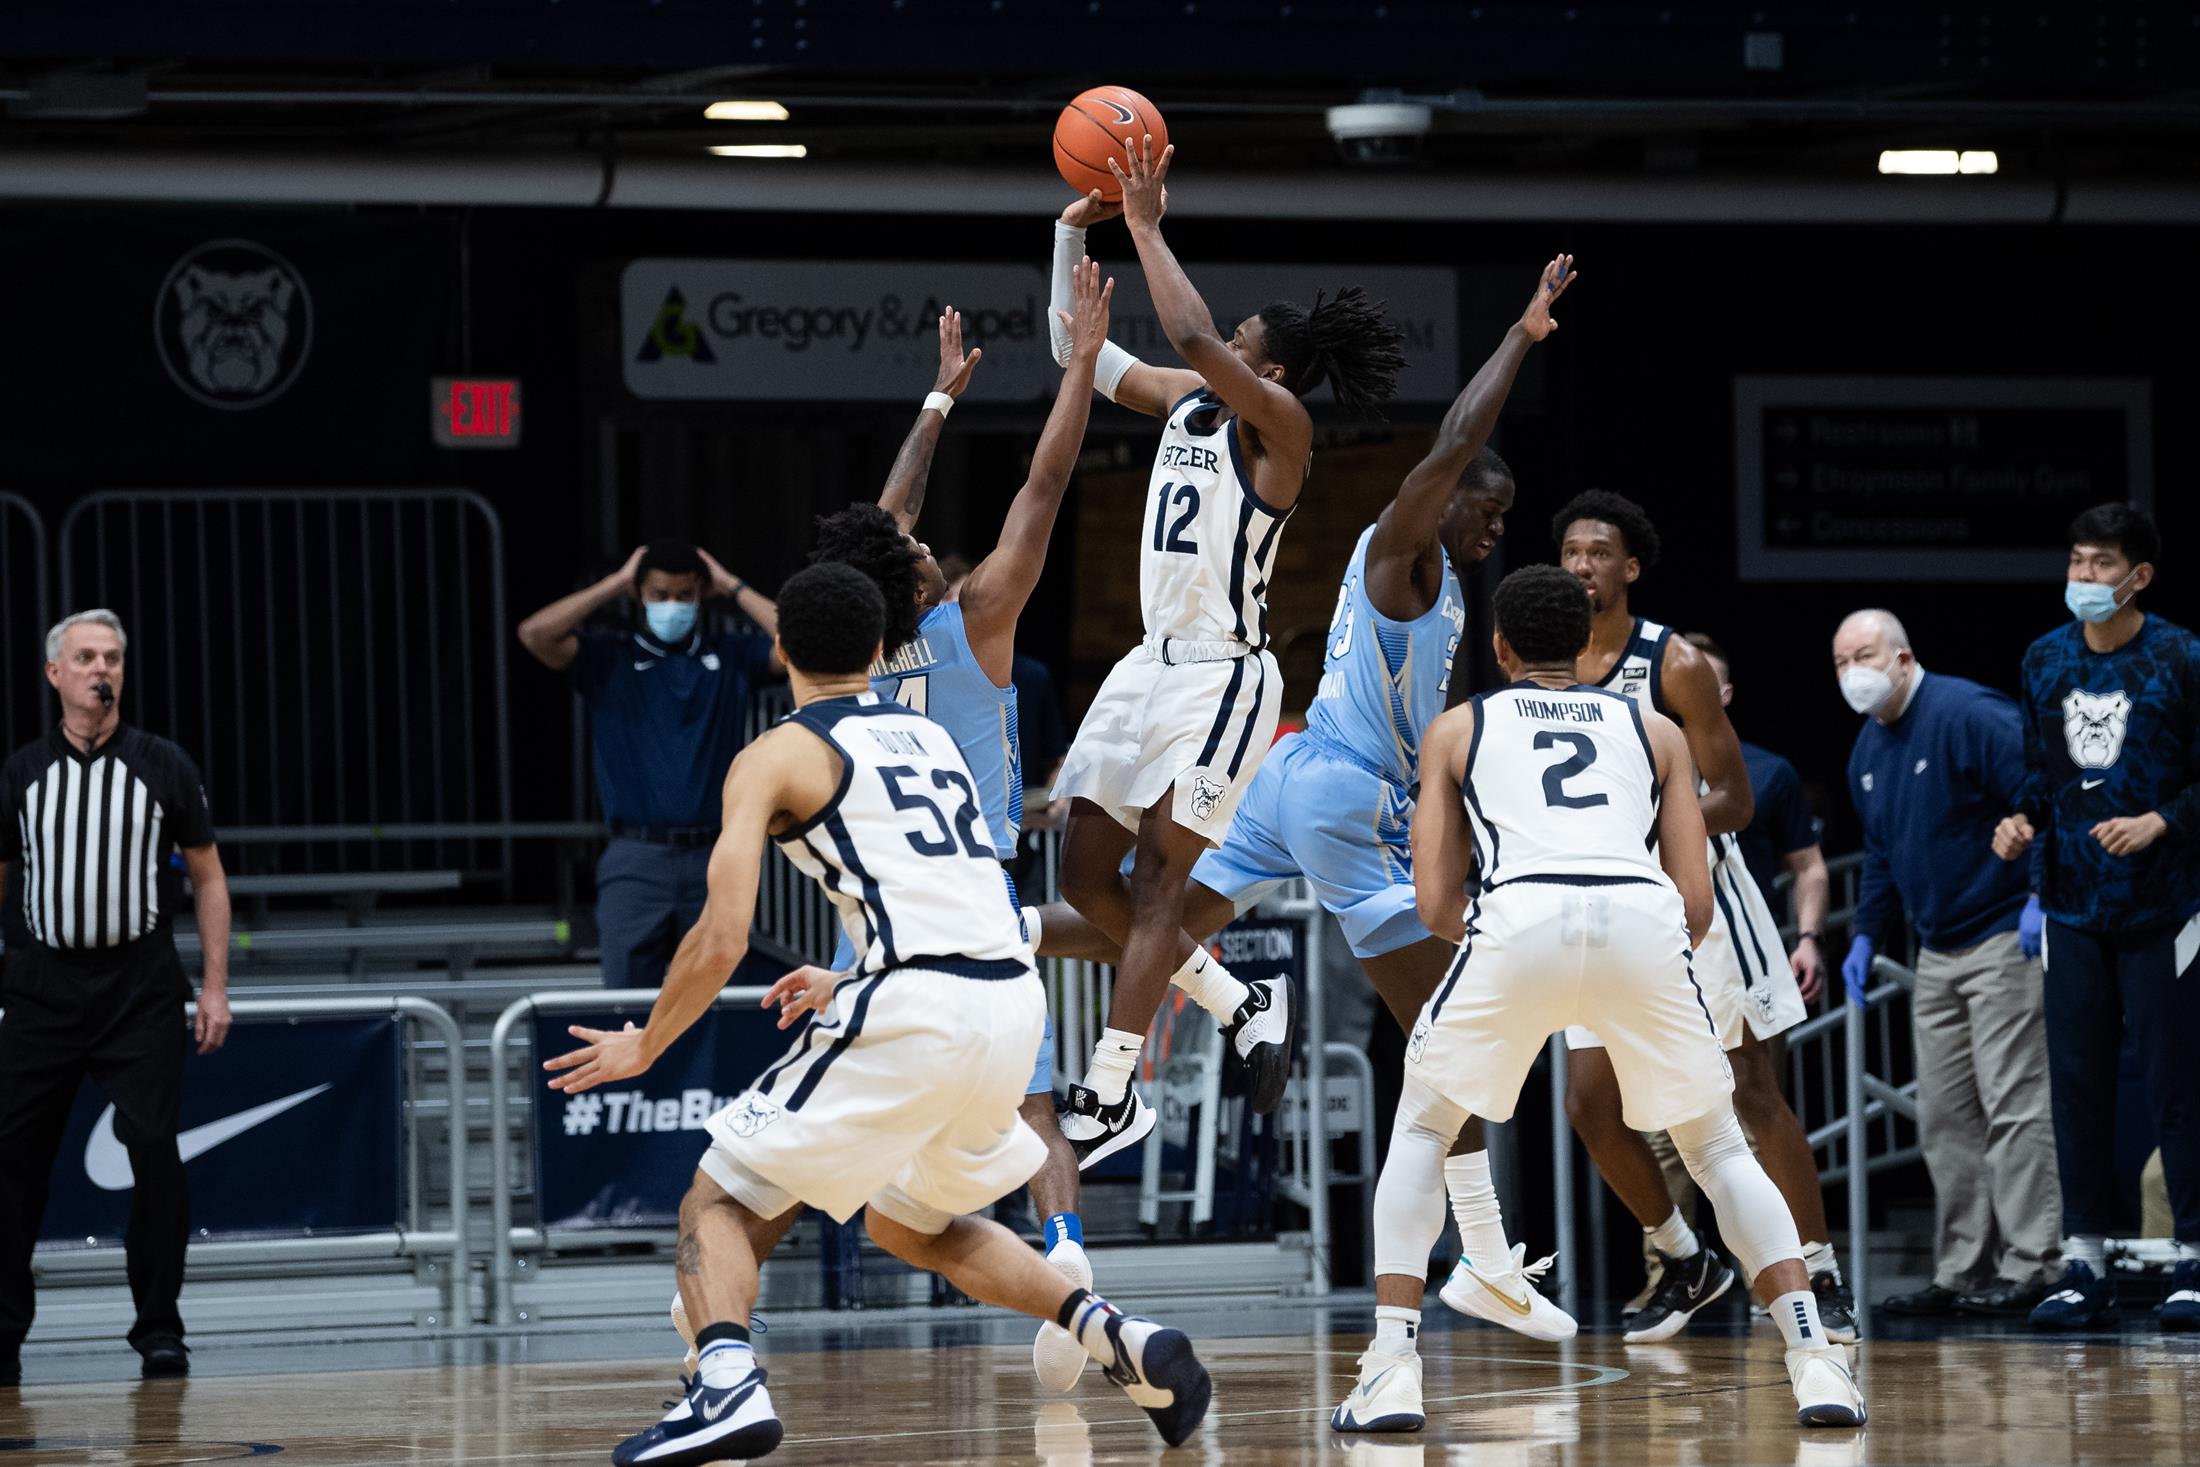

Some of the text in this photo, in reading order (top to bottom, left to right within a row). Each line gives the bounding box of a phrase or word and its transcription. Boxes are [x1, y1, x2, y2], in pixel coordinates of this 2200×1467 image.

[451, 382, 512, 437] EXIT
[1154, 482, 1200, 555] 12
[1514, 698, 1604, 722] THOMPSON
[1533, 731, 1609, 809] 2
[875, 766, 998, 858] 52
[1220, 928, 1294, 963] SECTION
